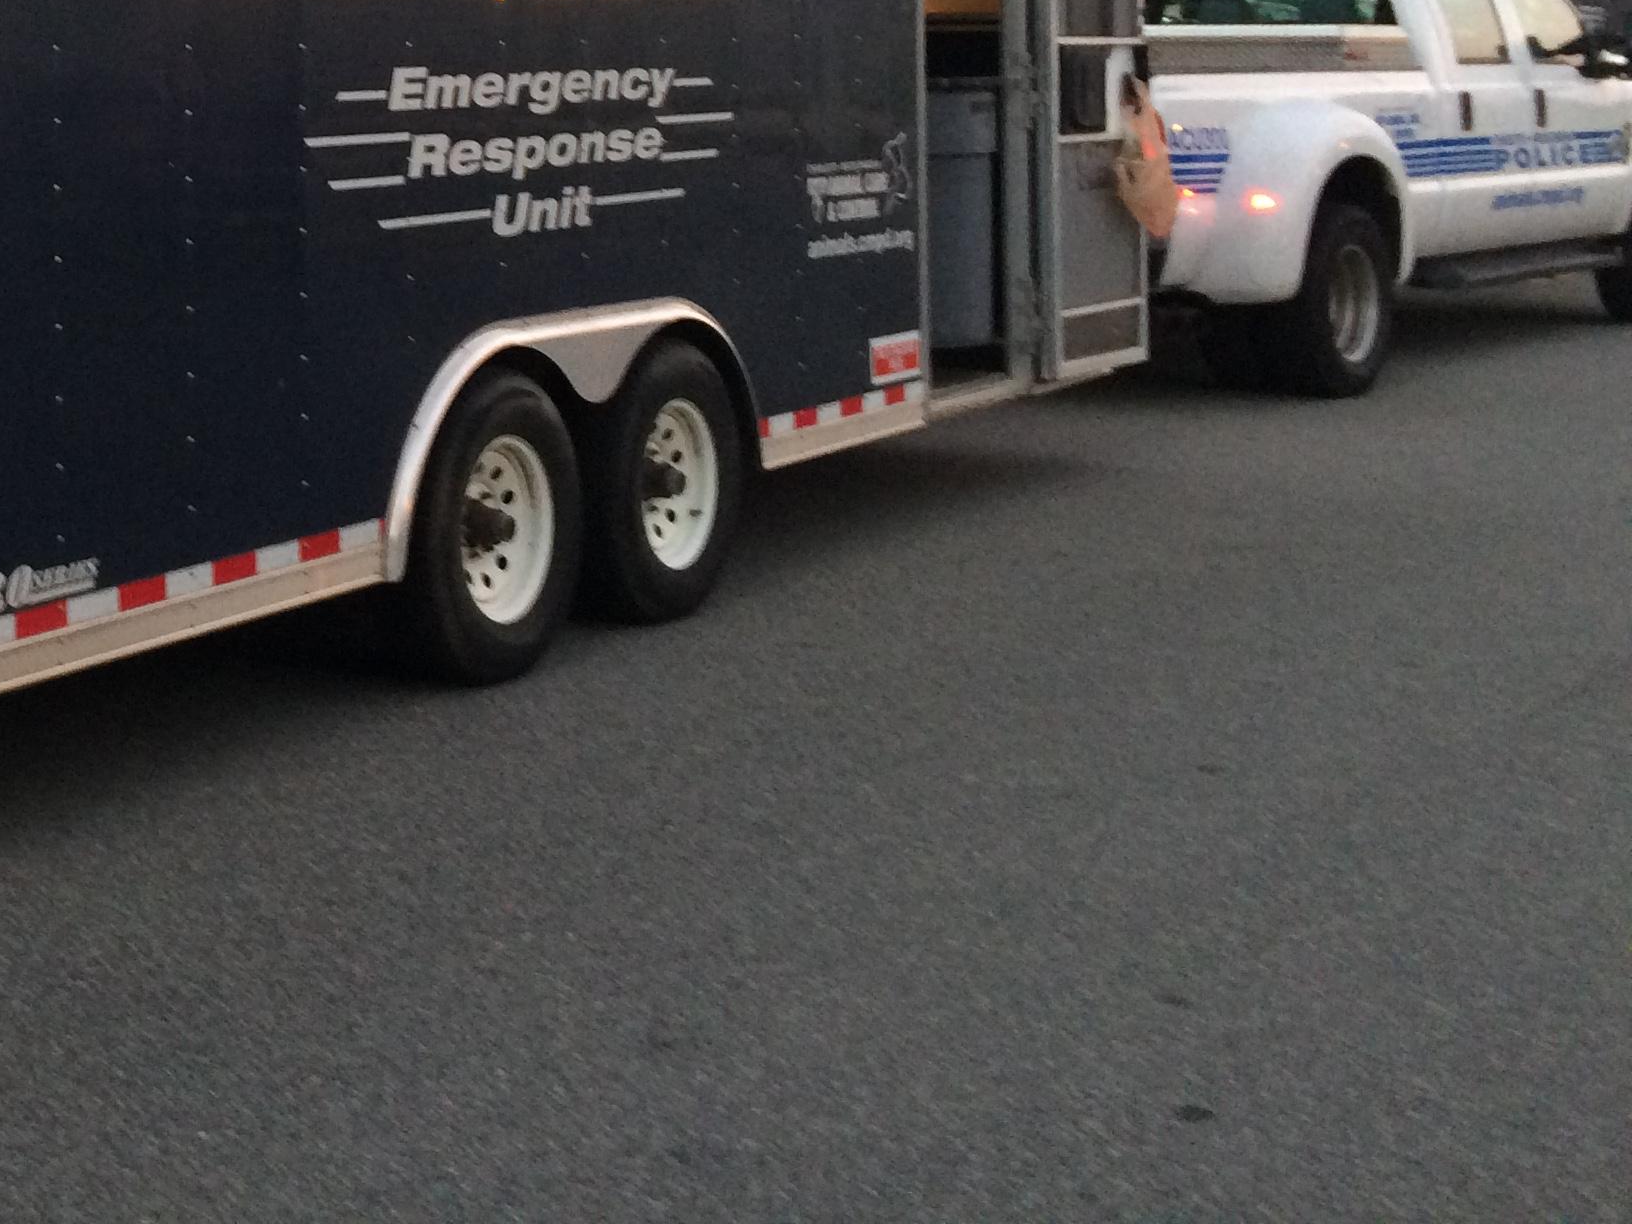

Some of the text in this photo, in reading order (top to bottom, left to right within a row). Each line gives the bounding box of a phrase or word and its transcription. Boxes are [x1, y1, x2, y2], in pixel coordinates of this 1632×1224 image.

[387, 66, 676, 114] Emergency
[407, 126, 664, 180] Response
[1495, 142, 1594, 172] POLICE
[491, 185, 592, 238] Unit
